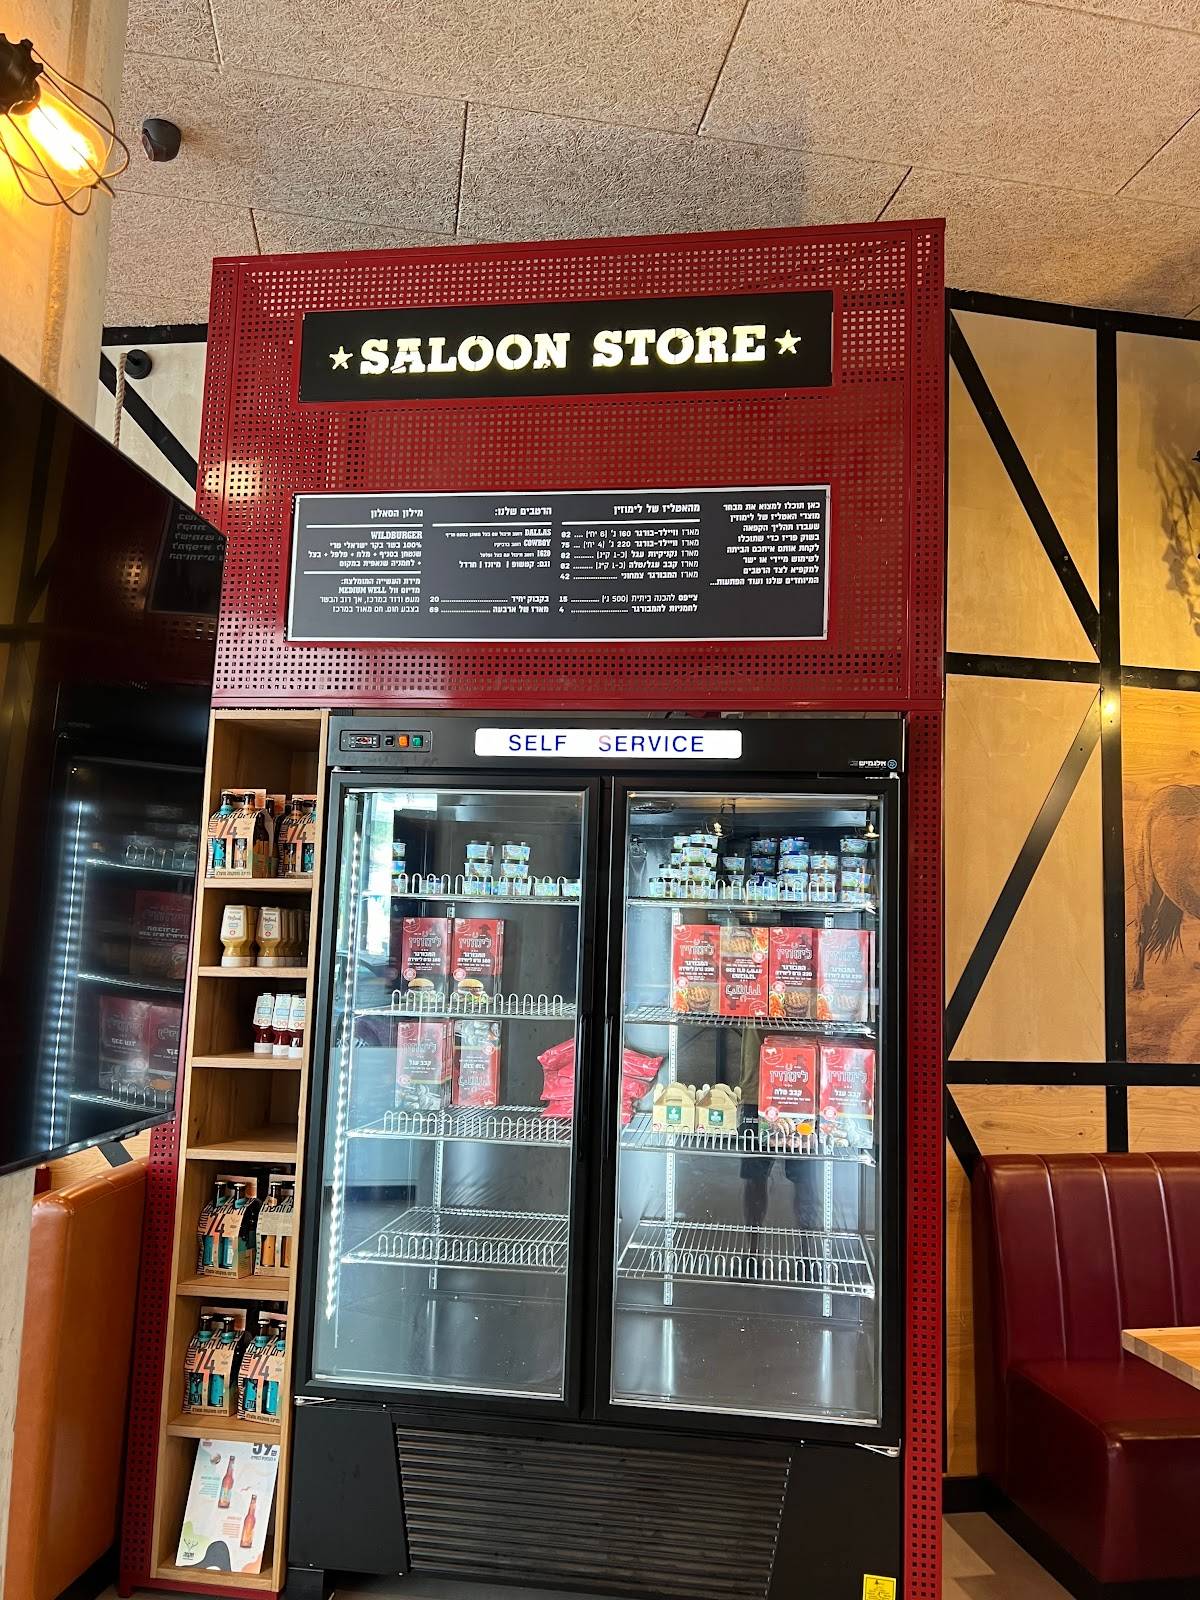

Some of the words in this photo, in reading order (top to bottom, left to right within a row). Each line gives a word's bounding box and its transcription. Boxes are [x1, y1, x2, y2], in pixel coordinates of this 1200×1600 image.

[360, 332, 570, 375] SALOON
[592, 325, 765, 368] STORE
[614, 504, 642, 515] לימוזין
[646, 504, 659, 512] של
[662, 503, 700, 512] מהאטליז
[808, 502, 820, 510] כאן
[371, 509, 399, 518] הסאלון
[402, 508, 423, 518] מילון
[495, 507, 517, 515] שלנו:
[730, 514, 754, 522] לימוזין
[771, 523, 793, 532] תהליך
[371, 531, 422, 539] WILDBURGER
[800, 534, 819, 542] בשוק
[370, 542, 383, 550] בקר
[799, 544, 819, 552] לקחת
[631, 550, 644, 558] עגל
[663, 561, 678, 569] קבב
[773, 565, 787, 573] לצד
[791, 564, 819, 574] למקפיא
[785, 576, 819, 584] המיוחדים
[519, 605, 529, 613] של
[508, 734, 567, 752] SELF
[598, 734, 704, 753] SERVICE
